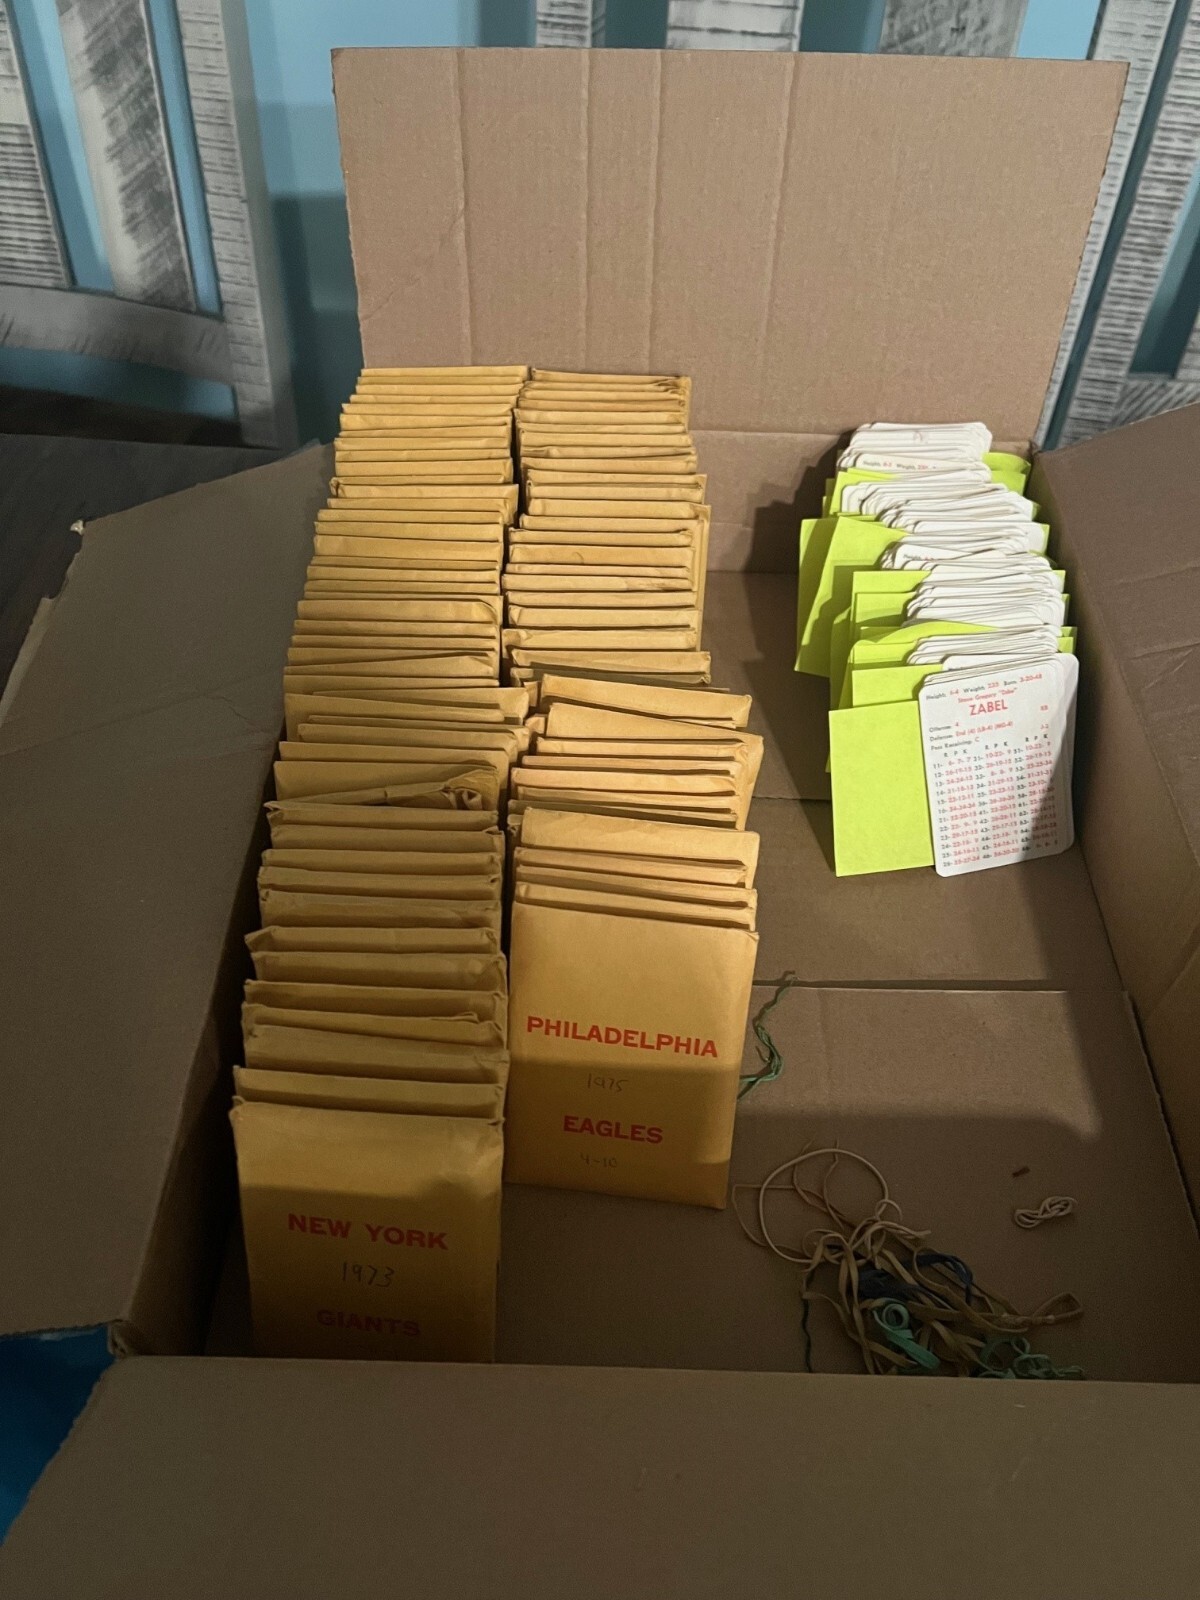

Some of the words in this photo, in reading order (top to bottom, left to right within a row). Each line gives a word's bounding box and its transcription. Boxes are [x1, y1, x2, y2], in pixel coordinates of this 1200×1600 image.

[969, 699, 1008, 716] ZABEL
[526, 1015, 718, 1058] PHILADELPHIA
[586, 1073, 629, 1093] 1975
[563, 1115, 664, 1145] EAGLES
[288, 1213, 350, 1239] NEW
[364, 1223, 448, 1250] YORK
[342, 1262, 395, 1288] 1973
[316, 1309, 421, 1337] GIANTS
